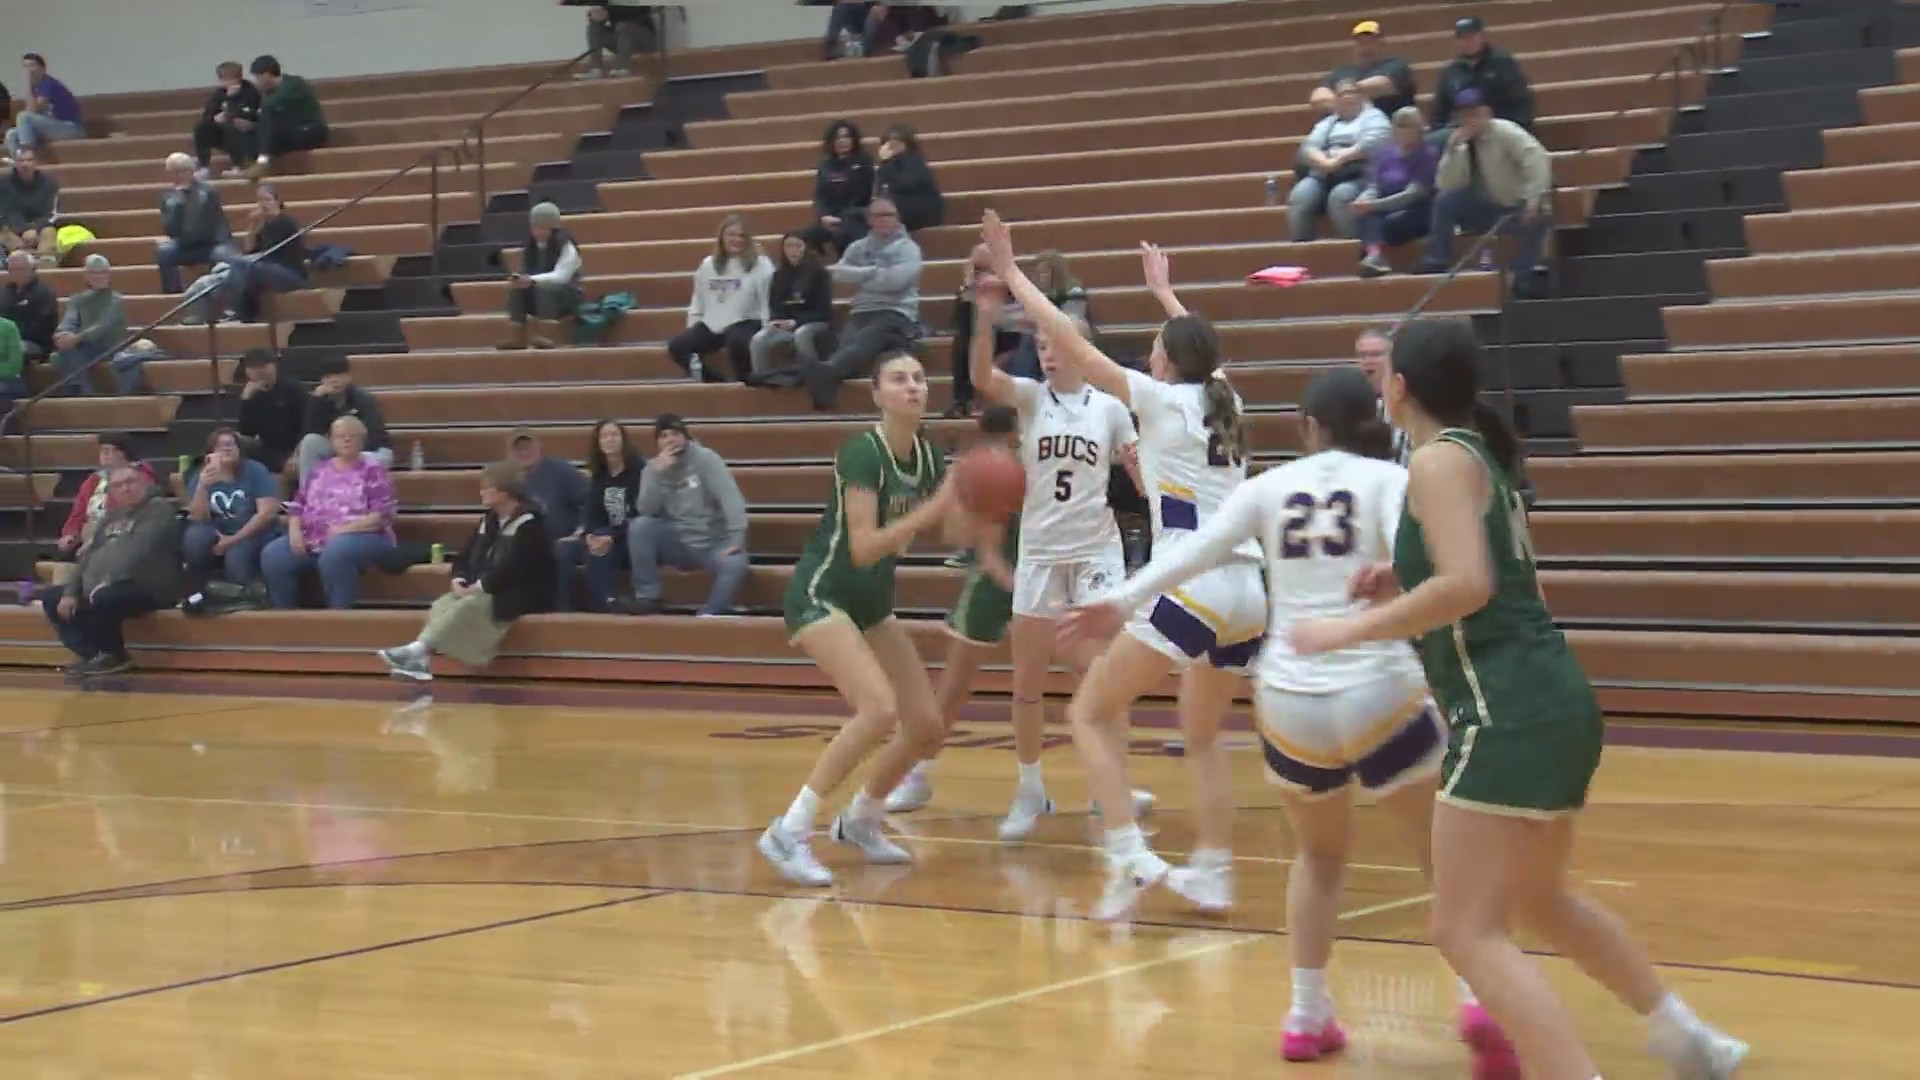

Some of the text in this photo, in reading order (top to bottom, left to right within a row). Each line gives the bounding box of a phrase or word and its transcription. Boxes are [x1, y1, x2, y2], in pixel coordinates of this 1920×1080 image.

[1038, 435, 1098, 467] BUCS
[1055, 470, 1073, 501] 5
[1280, 490, 1356, 559] 23
